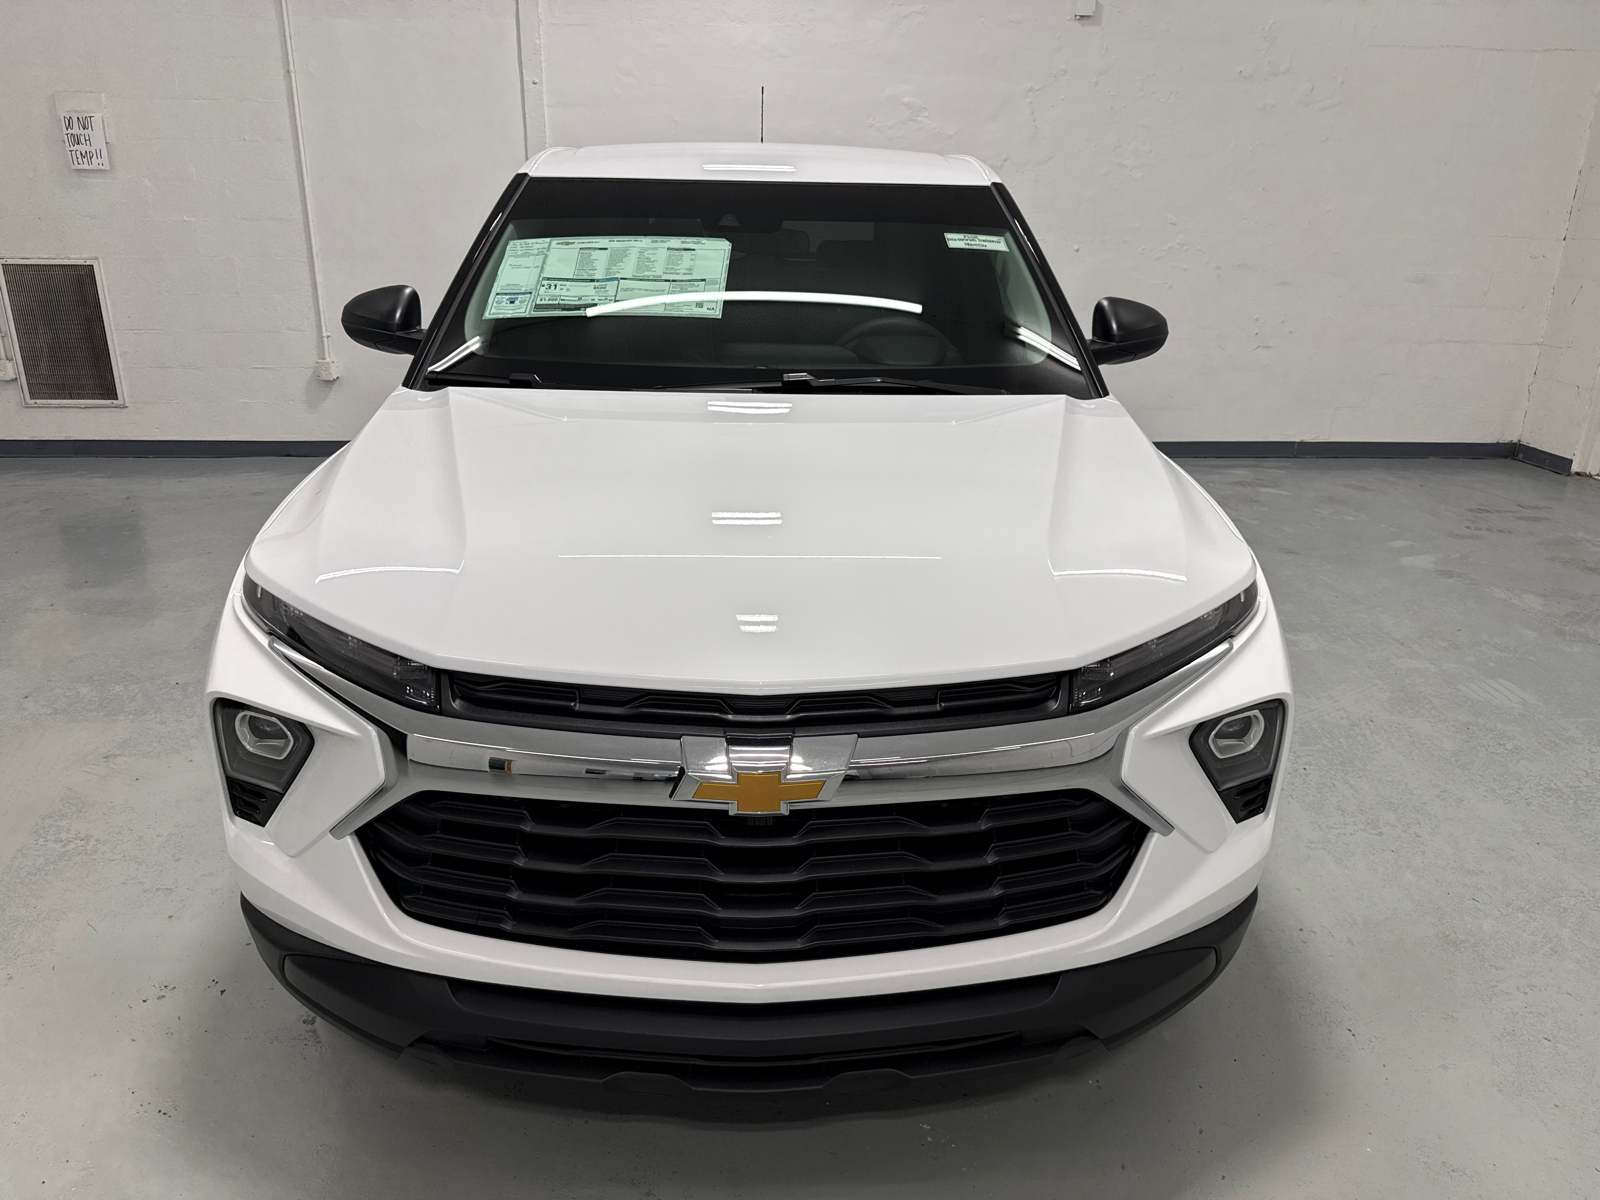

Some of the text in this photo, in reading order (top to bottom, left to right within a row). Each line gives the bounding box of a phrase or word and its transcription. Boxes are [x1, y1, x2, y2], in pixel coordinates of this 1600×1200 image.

[63, 116, 95, 131] DO NOT
[65, 133, 92, 147] TOUCH
[69, 149, 104, 166] TEMP!!
